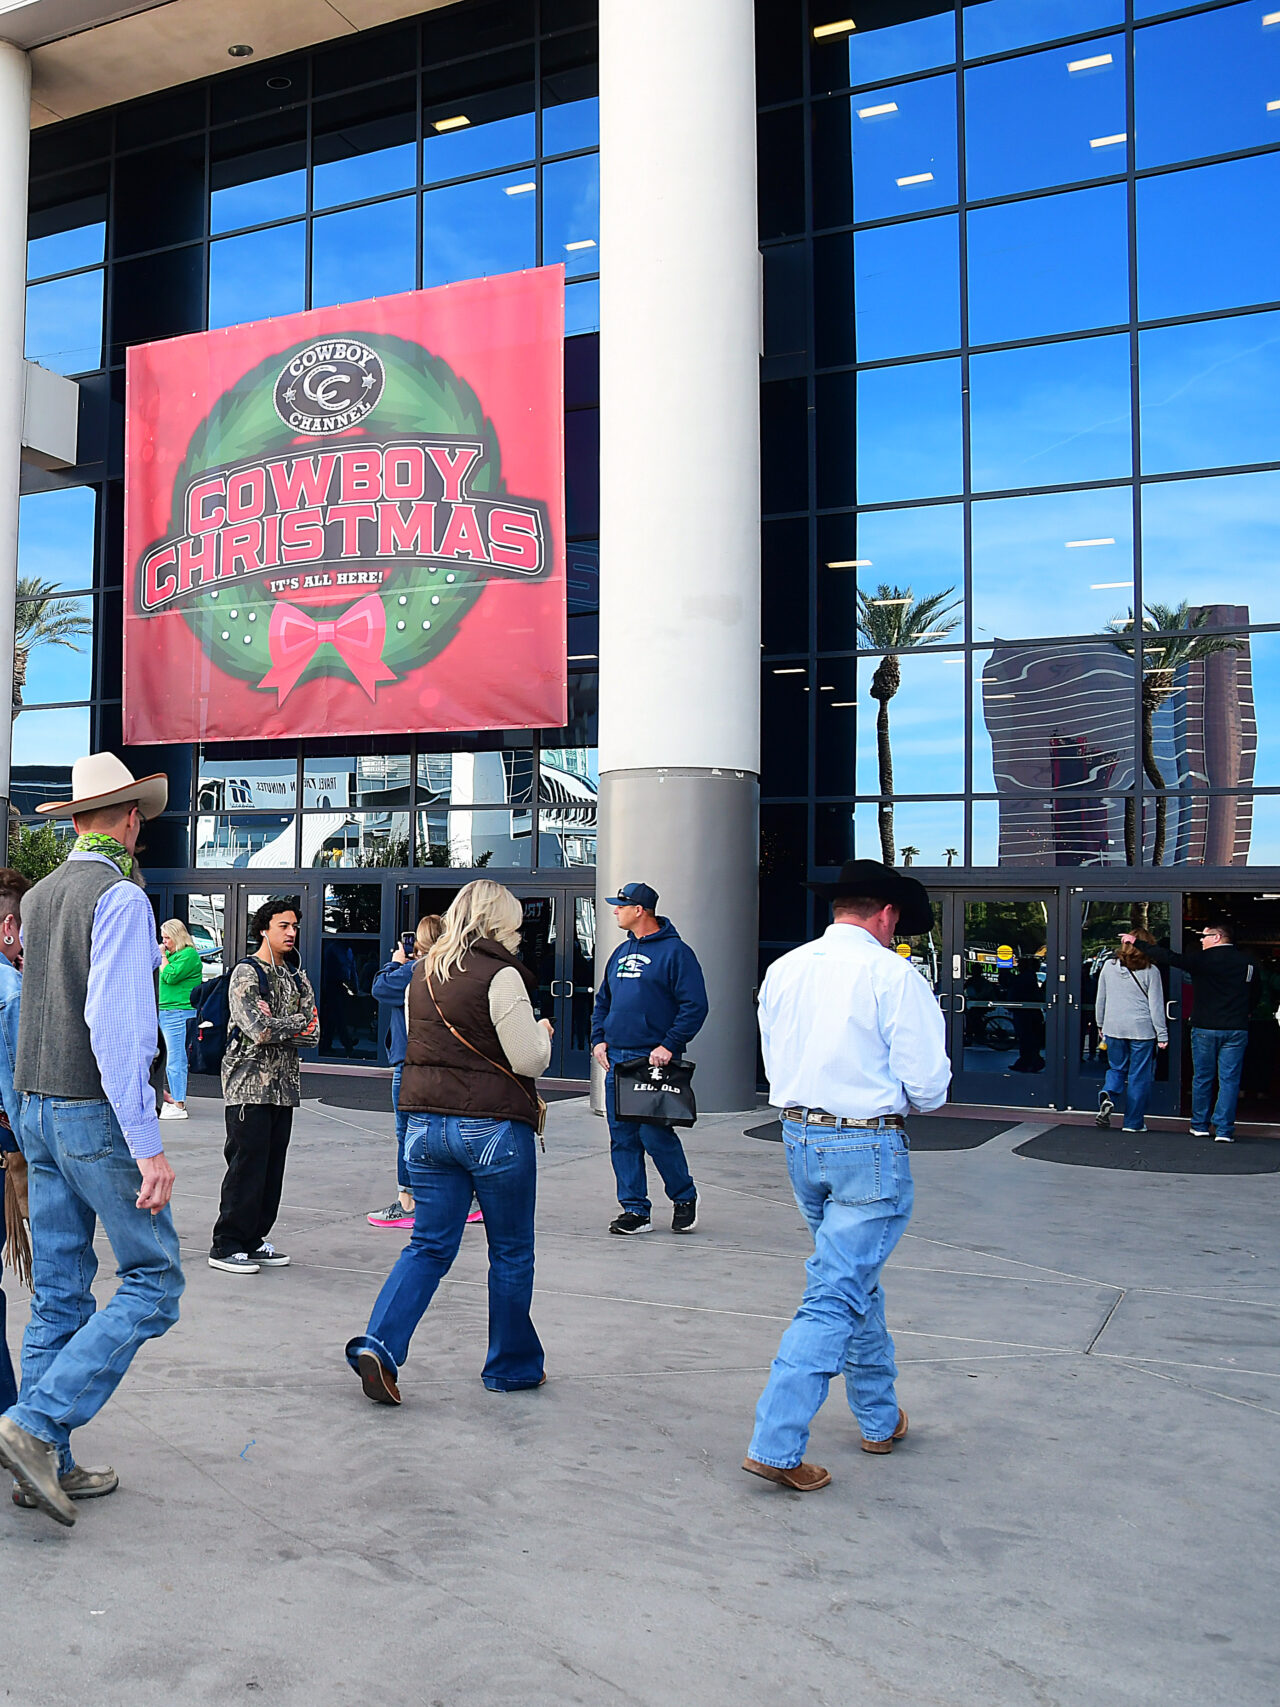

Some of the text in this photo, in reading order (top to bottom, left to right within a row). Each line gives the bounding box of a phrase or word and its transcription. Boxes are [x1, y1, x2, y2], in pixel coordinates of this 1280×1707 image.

[289, 343, 375, 377] COWBOY
[289, 401, 372, 431] CHANNEL
[187, 446, 483, 538] COWBOY
[142, 501, 545, 608] CHRISTMAS
[270, 571, 384, 593] IT'S ALL HERE!
[633, 1083, 681, 1094] LEUOLD
